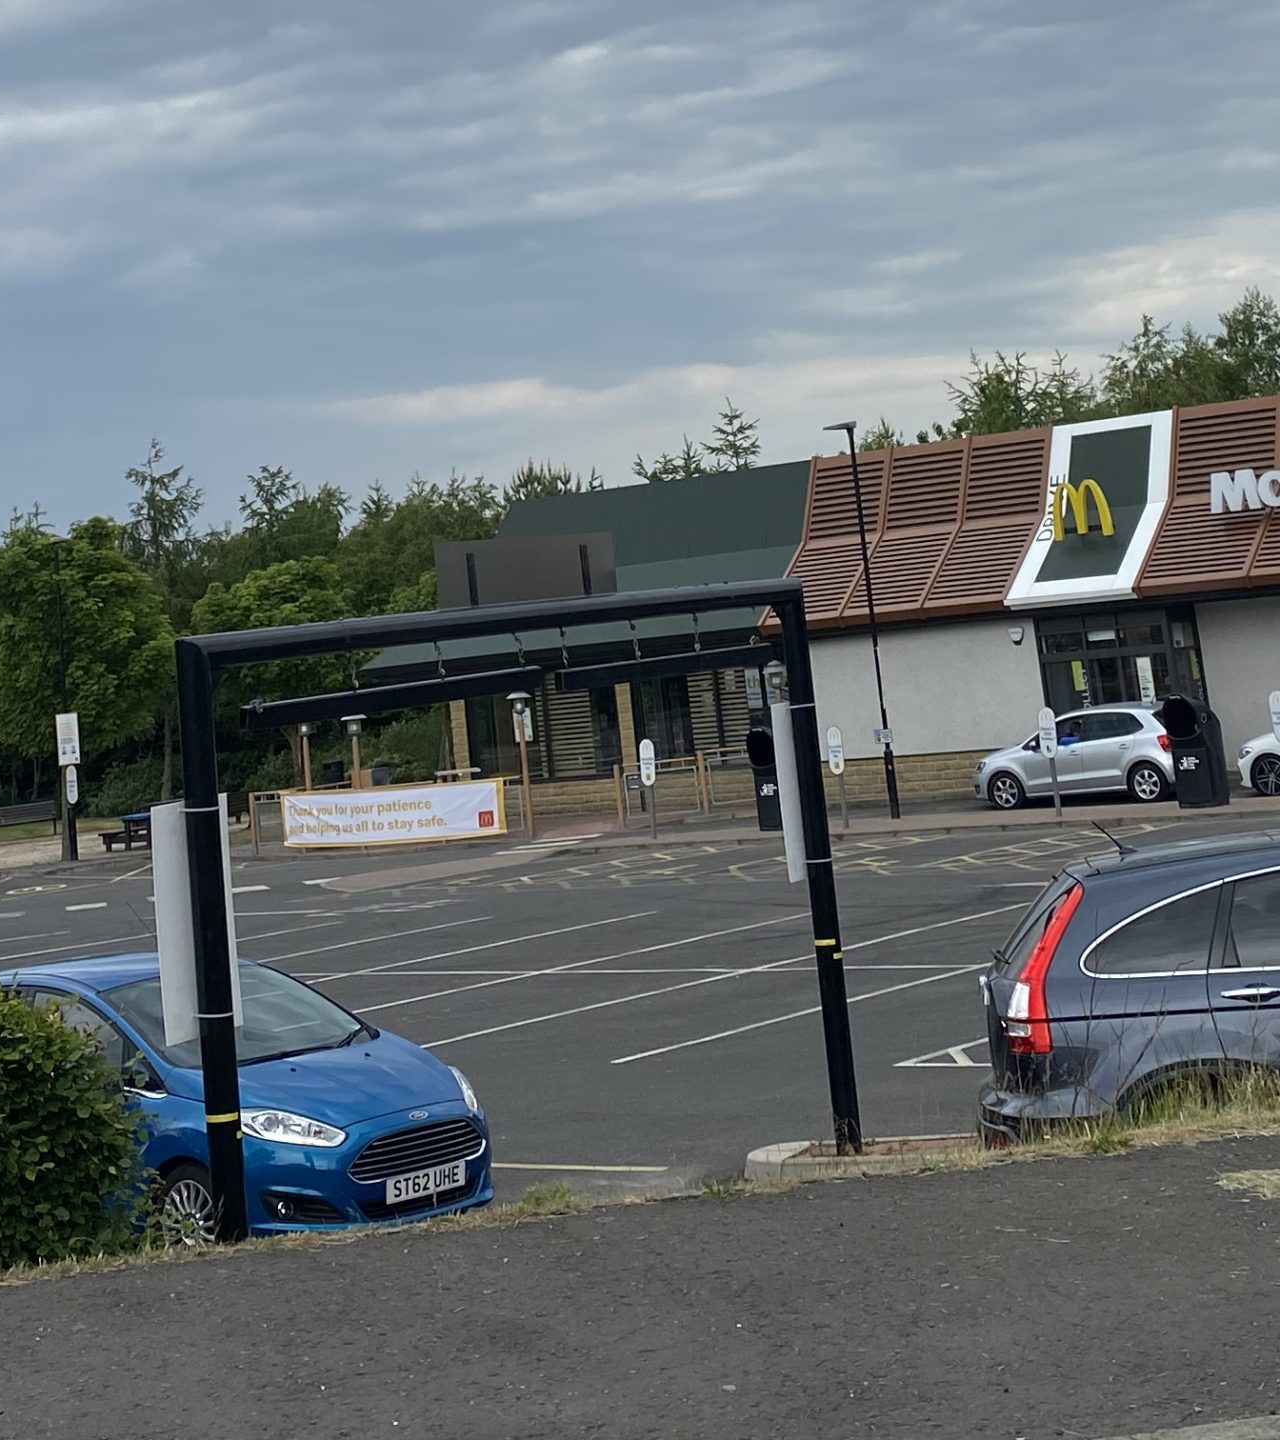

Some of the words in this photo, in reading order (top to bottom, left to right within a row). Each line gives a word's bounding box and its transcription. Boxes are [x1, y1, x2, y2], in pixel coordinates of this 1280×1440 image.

[287, 804, 314, 818] Thank
[315, 806, 333, 819] you
[334, 803, 349, 815] for
[350, 804, 374, 819] your
[376, 799, 433, 816] patience
[288, 822, 304, 834] and
[306, 821, 340, 837] helping
[342, 823, 354, 833] us
[355, 820, 369, 832] all
[371, 820, 384, 832] to
[387, 818, 414, 832] stay
[416, 814, 448, 828] safe.
[394, 1173, 430, 1198] ST62
[433, 1165, 460, 1188] UHE
